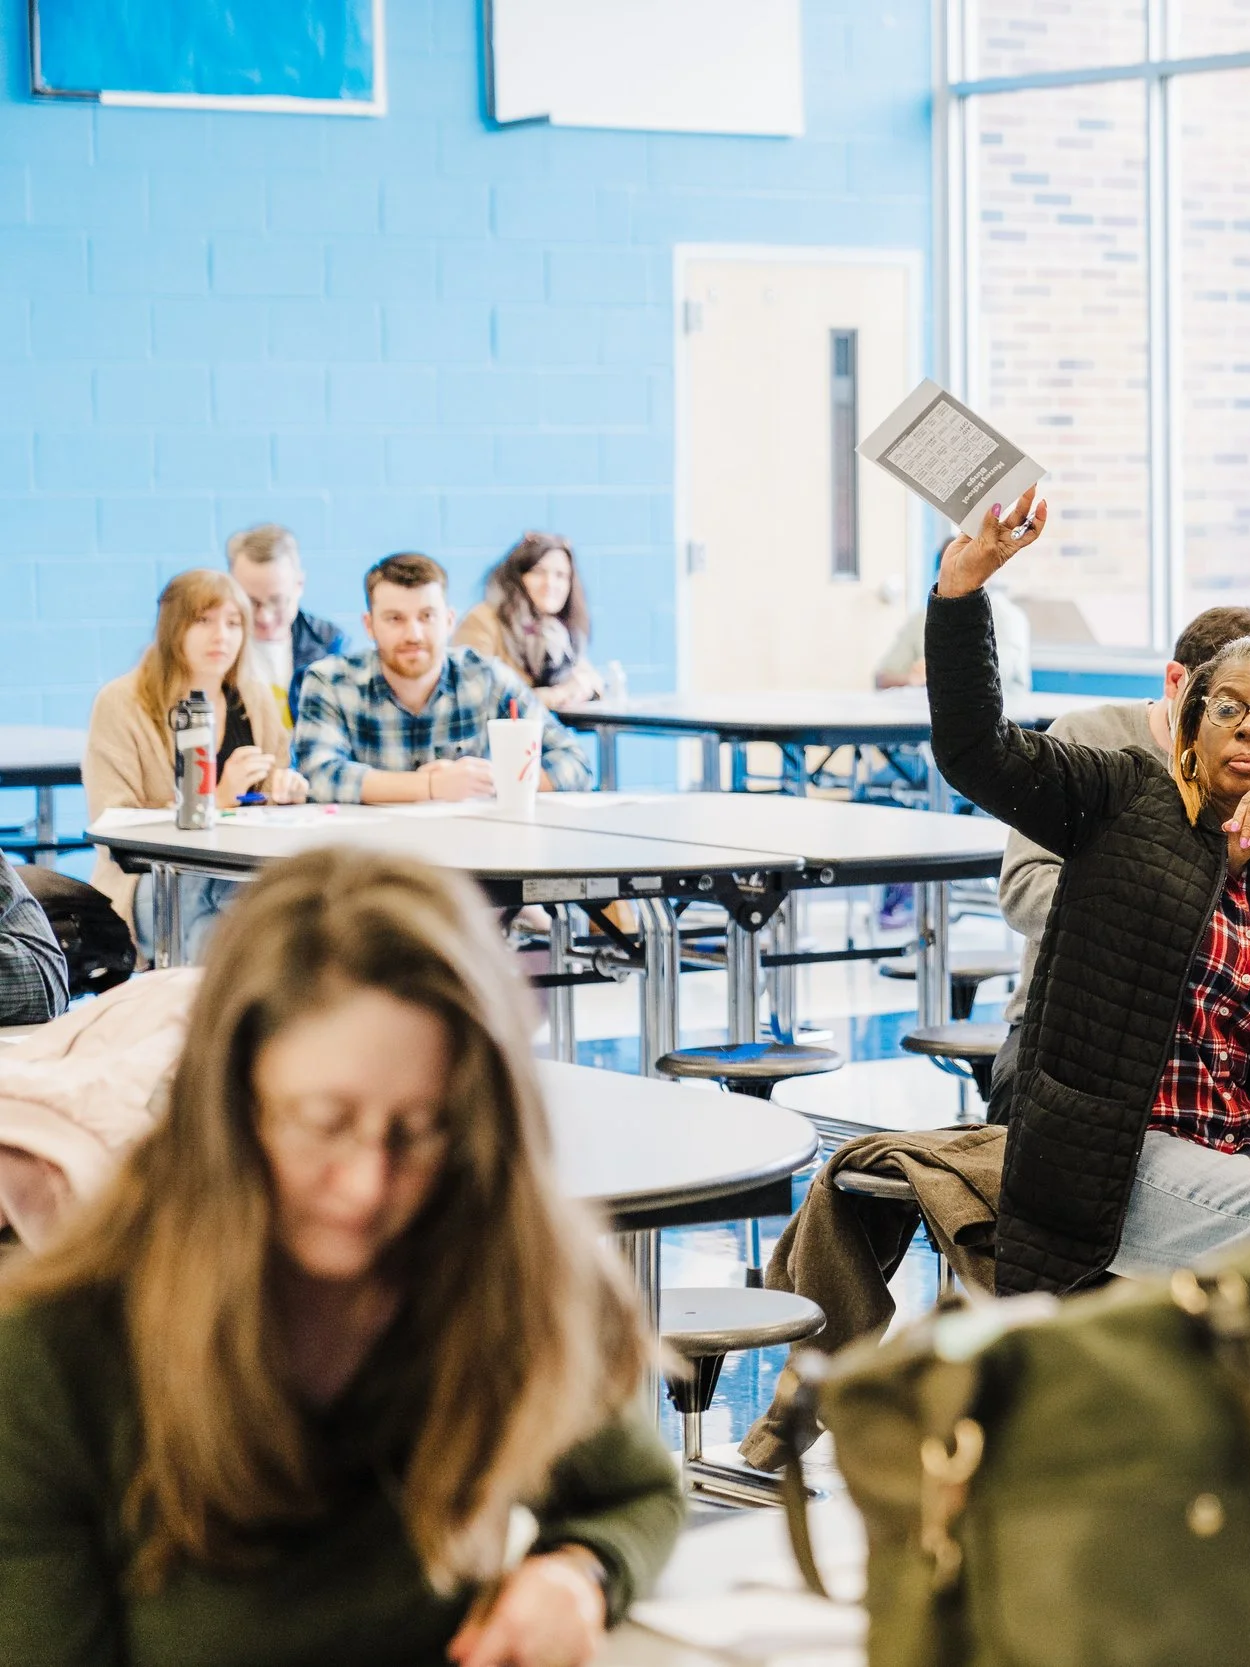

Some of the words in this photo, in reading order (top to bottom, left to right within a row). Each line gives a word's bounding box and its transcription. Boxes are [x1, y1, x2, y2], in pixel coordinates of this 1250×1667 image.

[966, 467, 987, 487] Bingo
[981, 461, 1005, 483] Money
[962, 481, 985, 504] School
